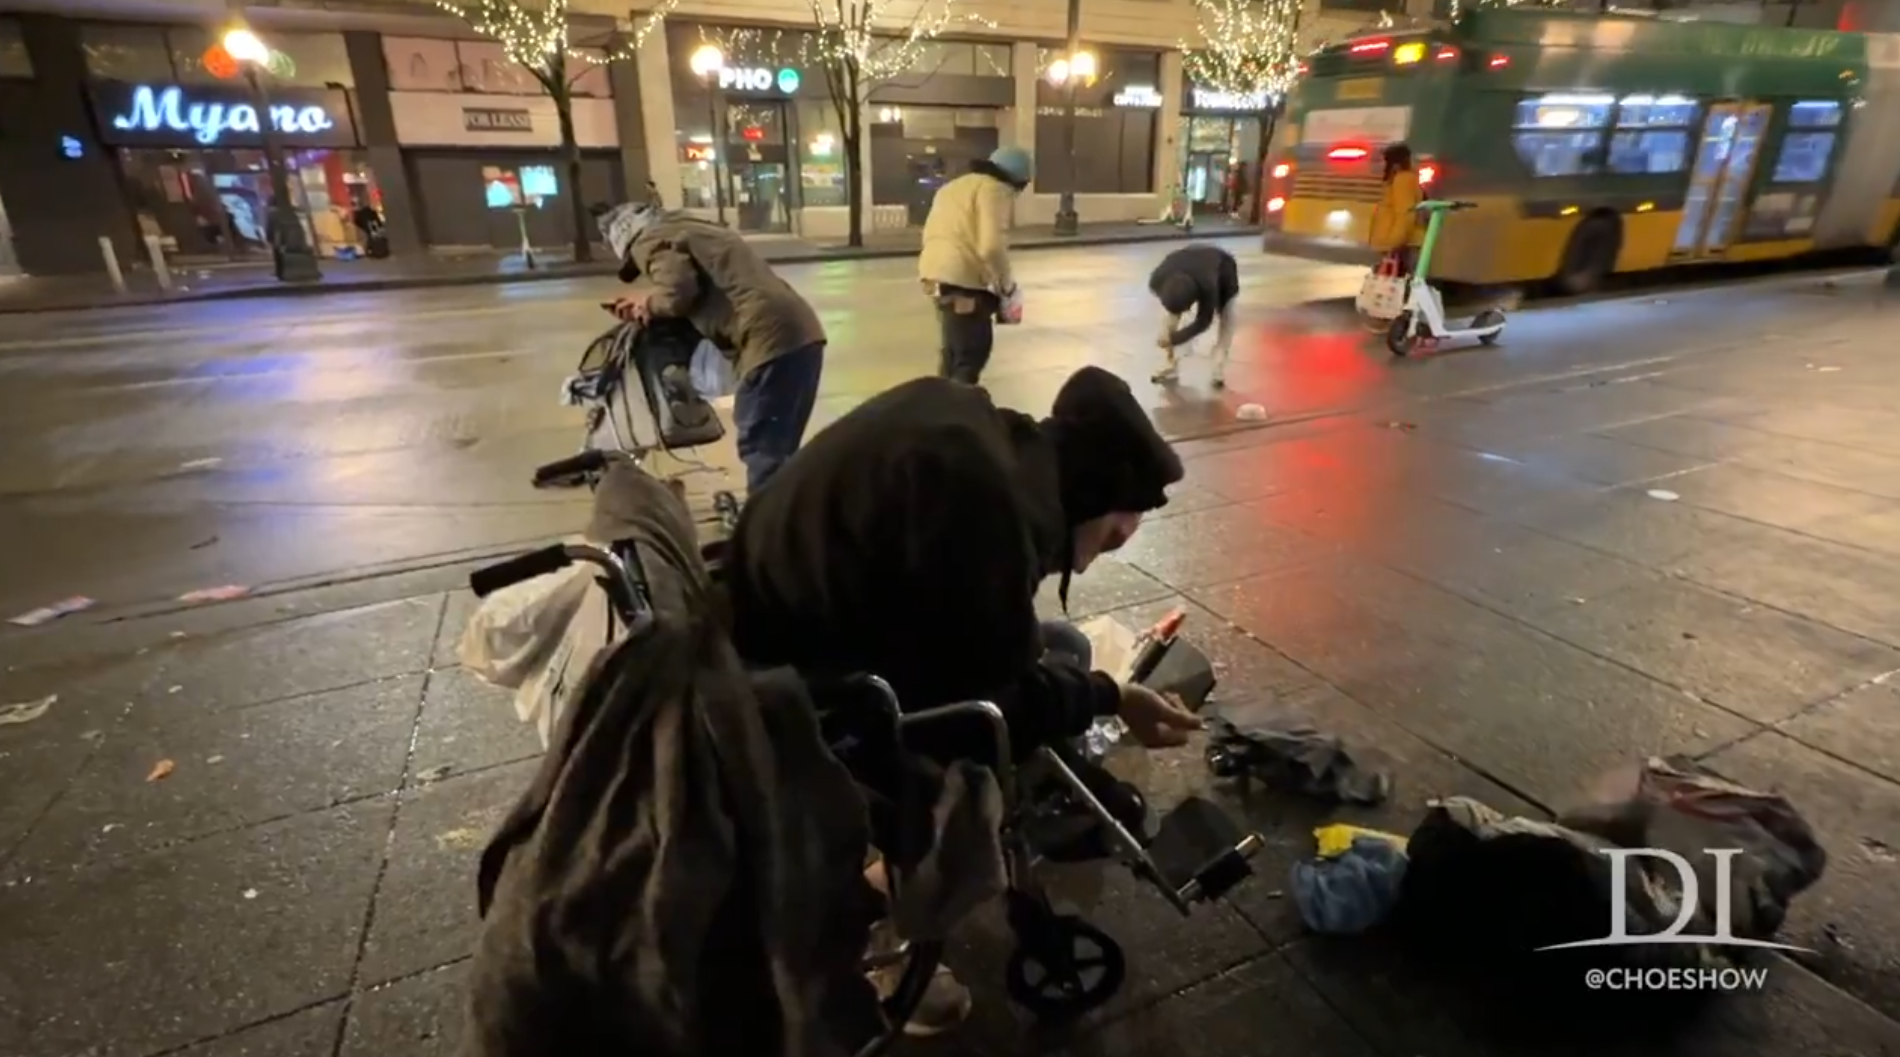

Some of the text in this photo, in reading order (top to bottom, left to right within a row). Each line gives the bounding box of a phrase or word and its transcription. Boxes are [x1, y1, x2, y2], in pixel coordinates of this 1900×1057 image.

[719, 67, 772, 90] PHO
[463, 111, 533, 130] FOR LEASE
